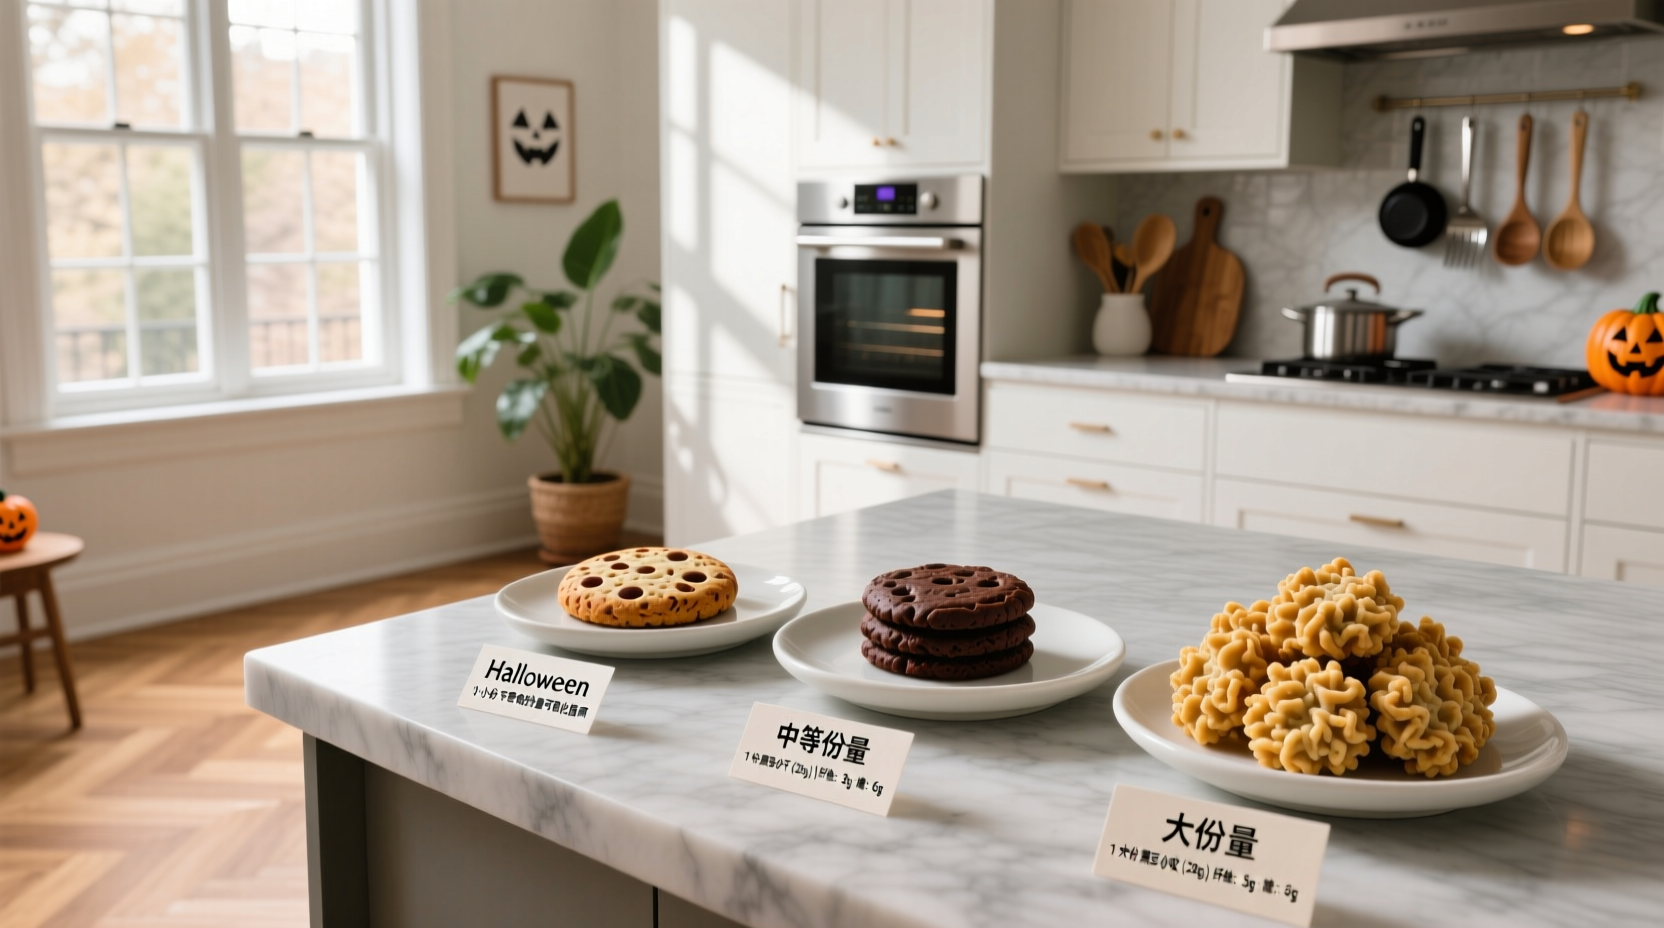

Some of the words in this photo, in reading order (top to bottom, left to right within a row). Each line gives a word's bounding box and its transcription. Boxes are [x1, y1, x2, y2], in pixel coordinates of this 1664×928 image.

[484, 659, 590, 697] Halloween
[777, 722, 870, 766] 中等份量
[1161, 812, 1259, 861] 大份量
